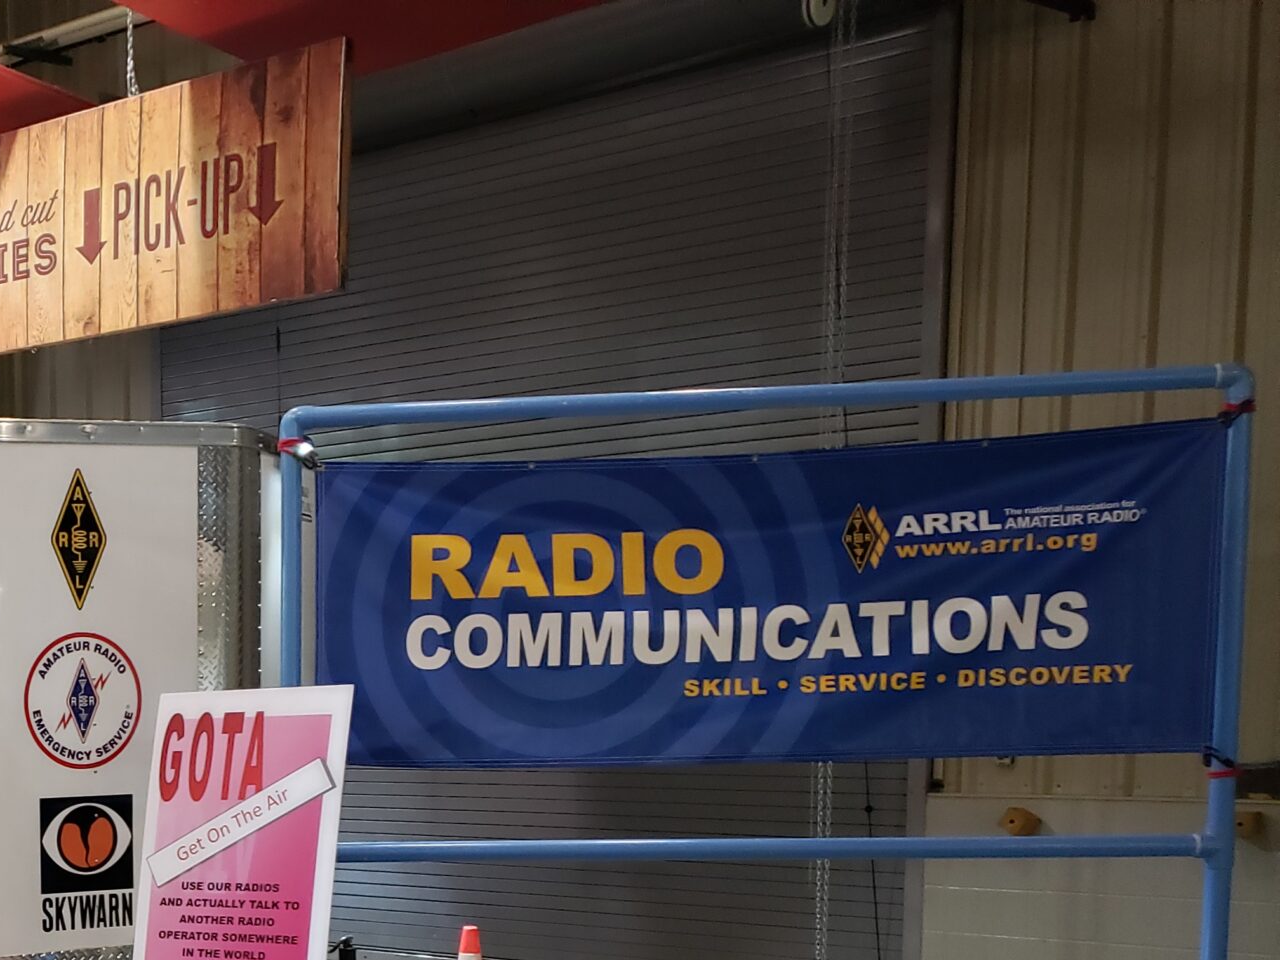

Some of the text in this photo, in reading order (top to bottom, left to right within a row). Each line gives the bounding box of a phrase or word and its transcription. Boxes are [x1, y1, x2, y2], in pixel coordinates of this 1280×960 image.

[20, 189, 59, 228] cut
[113, 153, 244, 260] PICK-UP
[895, 510, 1002, 537] ARRL
[1004, 508, 1023, 516] The
[1025, 504, 1062, 514] national
[1064, 502, 1120, 512] association
[1005, 513, 1084, 529] AMATEUR
[895, 533, 1097, 558] www.arrl.org
[410, 528, 725, 600] RADIO
[405, 590, 1089, 670] COMMUNICATIONS
[38, 641, 127, 680] AMATEUR RADIO
[683, 664, 1133, 697] SKILL SERVICE DISCOVERY
[33, 710, 134, 761] EMERGENCY SERVICE
[159, 711, 264, 802] GOTA
[176, 788, 288, 861] Get On The Air
[181, 881, 280, 893] USE OUR RADIOS
[42, 892, 133, 932] SKYWARN
[160, 897, 300, 911] AND ACTUALLY TALK TO
[158, 930, 298, 945] OPERATOR SOMEWHERE
[179, 915, 275, 927] ANOTHER RADIO
[182, 948, 266, 960] IN THE WORLD
